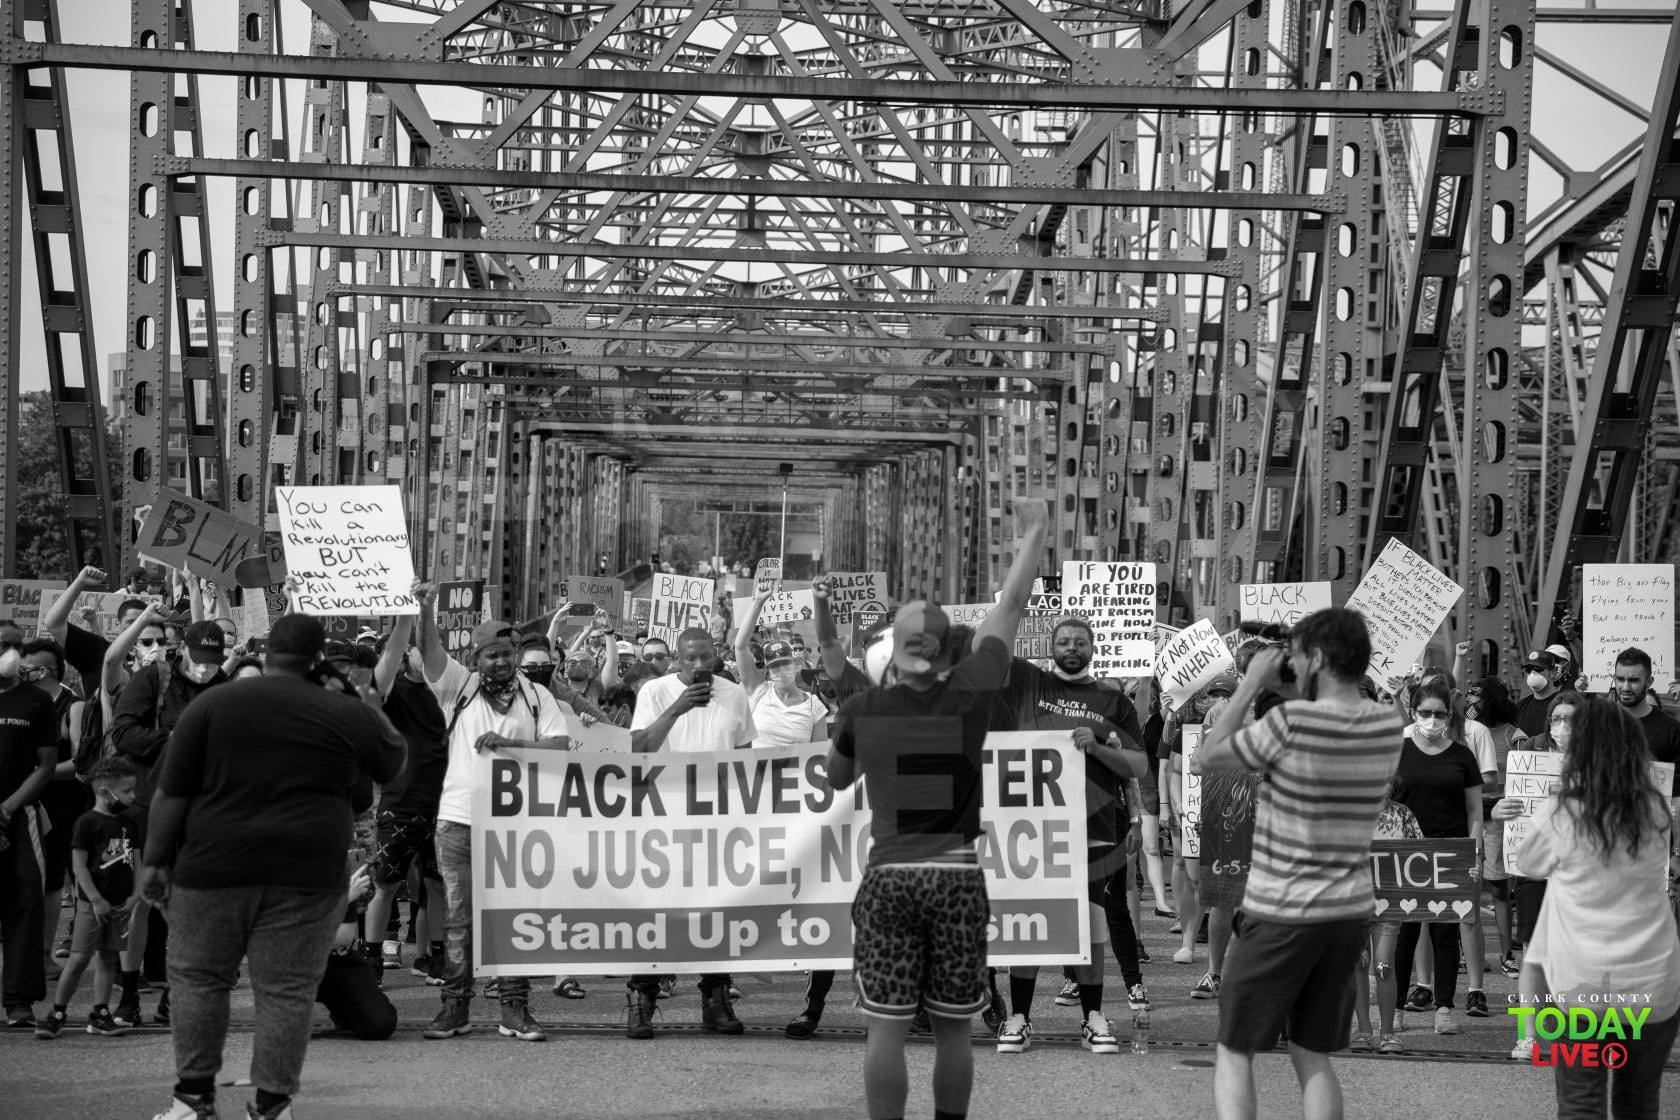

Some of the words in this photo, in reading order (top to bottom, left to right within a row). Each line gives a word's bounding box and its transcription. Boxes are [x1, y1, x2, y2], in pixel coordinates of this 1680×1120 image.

[347, 521, 364, 529] a
[151, 500, 250, 574] BLM
[288, 532, 408, 548] Revolutionary
[319, 547, 367, 566] BUT
[292, 570, 331, 585] you
[339, 561, 390, 578] can't
[1079, 563, 1096, 581] IF
[1108, 564, 1143, 582] YOU
[1388, 540, 1402, 551] IF
[1401, 550, 1431, 575] BLACK
[1431, 573, 1454, 592] LIVES
[355, 581, 389, 591] the
[580, 581, 613, 599] RACISM
[661, 576, 707, 601] BLACK
[832, 575, 875, 589] BLACK
[1080, 583, 1110, 595] ARE
[1116, 583, 1155, 596] TIRED
[1406, 569, 1442, 595] MATTER
[449, 587, 473, 608] NO
[833, 587, 876, 601] LIVES
[1028, 595, 1061, 609] LAC
[1068, 596, 1086, 606] OF
[1093, 596, 1150, 608] HEARING
[1245, 585, 1307, 605] BLACK
[1389, 589, 1408, 605] LIVES
[299, 595, 419, 611] REVOLUTION!
[763, 603, 793, 613] IVES
[653, 600, 711, 632] LIVES
[759, 613, 799, 623] ATTER
[834, 613, 852, 625] TE
[1064, 608, 1103, 617] ABOUT
[1108, 608, 1154, 617] RACISM
[1257, 607, 1312, 624] LIVE
[1090, 619, 1116, 628] GINE
[1123, 619, 1152, 627] HOW
[448, 630, 471, 649] NO
[1089, 659, 1150, 668] RIENCING
[1171, 638, 1222, 688] WHEN?
[1057, 699, 1080, 709] BLACK
[1064, 708, 1085, 717] THAN
[1086, 711, 1104, 724] EVER
[1512, 755, 1549, 772] WE
[492, 759, 667, 818] BLACK
[686, 754, 834, 814] LIVES
[485, 829, 555, 889] NO
[572, 826, 801, 899] JUSTICE,
[976, 819, 1071, 879] ACE
[1369, 852, 1459, 890] TICE
[511, 912, 667, 951] Stand
[688, 911, 759, 957] Up
[777, 908, 831, 946] to
